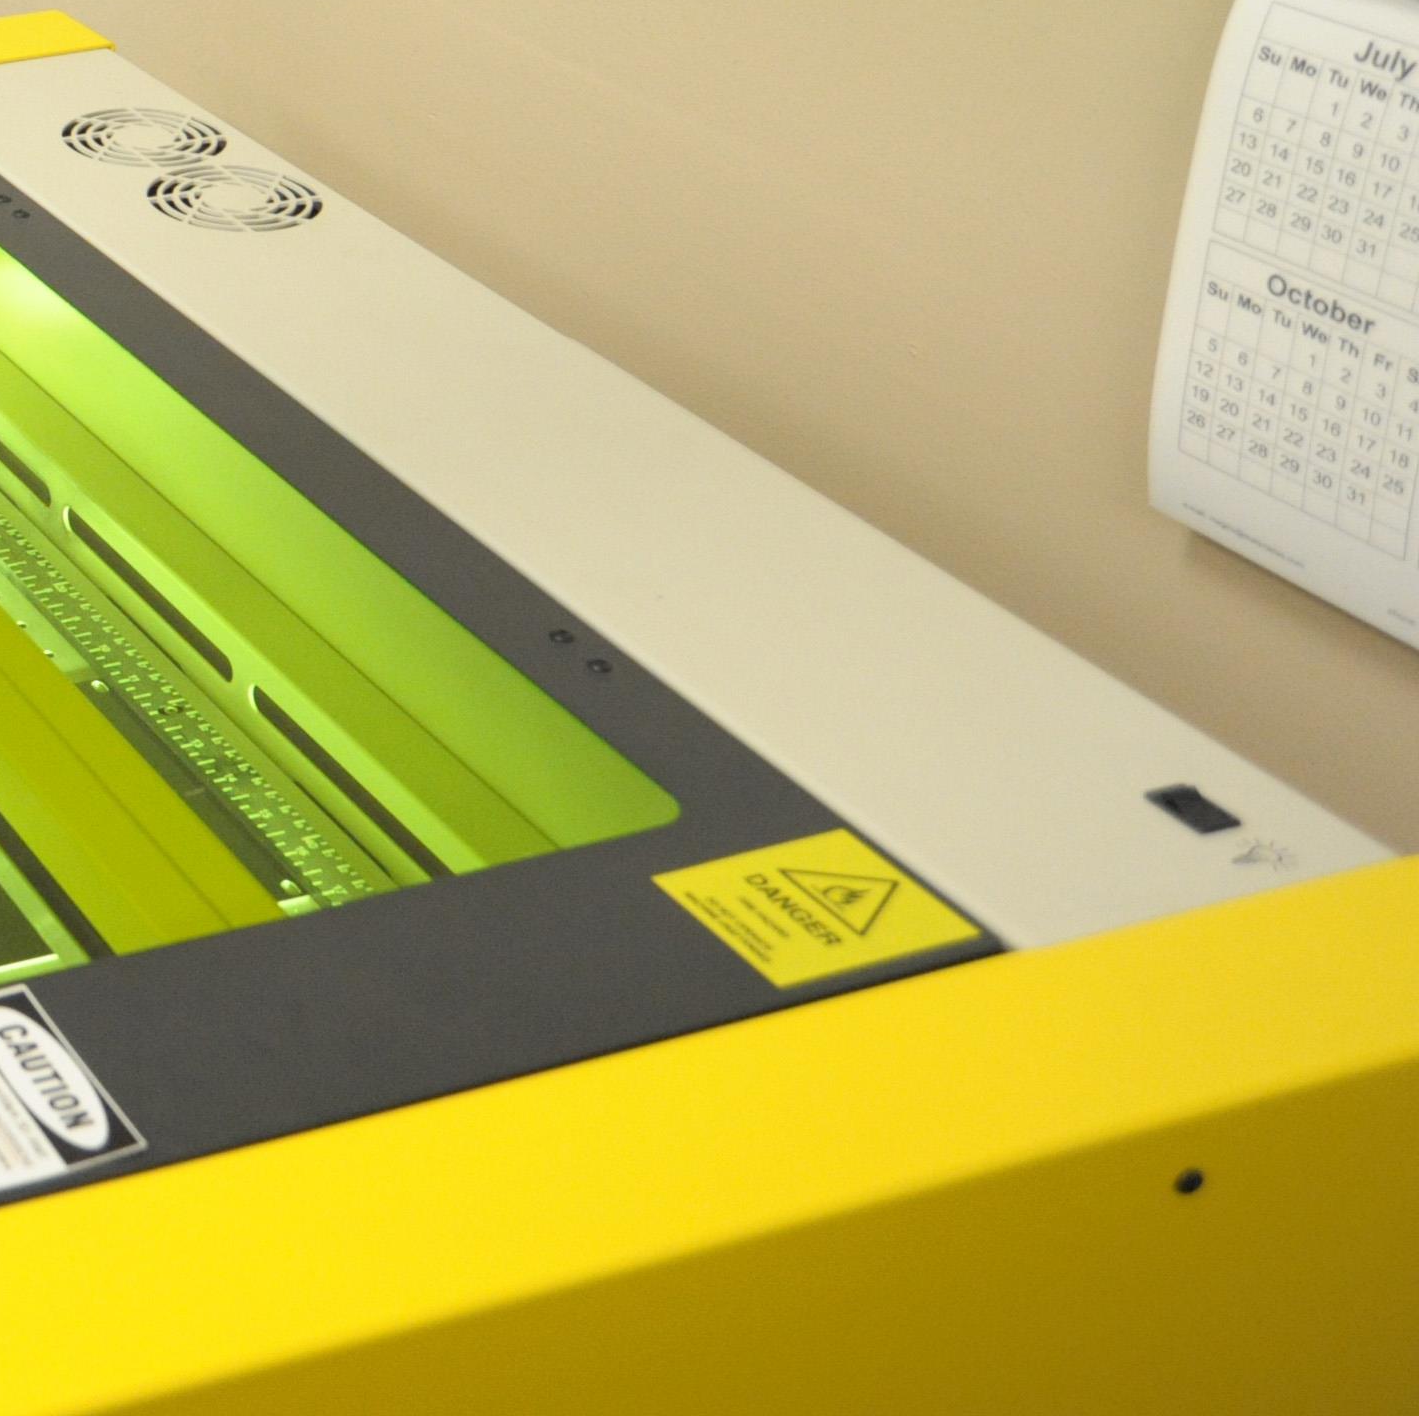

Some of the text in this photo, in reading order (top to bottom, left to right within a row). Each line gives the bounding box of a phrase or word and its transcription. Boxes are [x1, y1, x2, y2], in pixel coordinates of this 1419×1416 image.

[1258, 45, 1282, 66] Su
[1290, 56, 1317, 78] Mo
[1329, 68, 1349, 88] Tu
[1359, 79, 1387, 101] We
[1353, 41, 1417, 82] July
[1253, 107, 1401, 172] 6 7 8 9 10
[1331, 102, 1410, 142] 1 2 3
[1230, 158, 1252, 177] 20
[1262, 170, 1281, 189] 21
[1296, 183, 1318, 203] 22
[1328, 195, 1350, 215] 23
[1363, 210, 1385, 229] 24
[1239, 131, 1258, 150] 13
[1271, 144, 1289, 162] 14
[1306, 156, 1324, 175] 15
[1337, 168, 1356, 187] 16
[1373, 182, 1393, 199] 17
[1225, 186, 1376, 258] 27 28 29 30 31
[1206, 281, 1229, 301] Su
[1237, 294, 1262, 315] Mo
[1273, 309, 1291, 329] Tu
[1301, 322, 1328, 344] We
[1338, 337, 1360, 358] Th
[1373, 353, 1393, 372] Fr
[1267, 274, 1375, 334] October
[1195, 360, 1410, 469] 12 13 14 15 16 17 18
[1208, 338, 1413, 442] 5 6 7 8 9 10 11
[1340, 368, 1351, 384] 2
[1376, 384, 1386, 400] 3
[1187, 410, 1366, 505] 26 27 28 29 30 31
[1192, 385, 1404, 495] 19 20 21 22 23 24 25
[744, 873, 841, 945] DANGER
